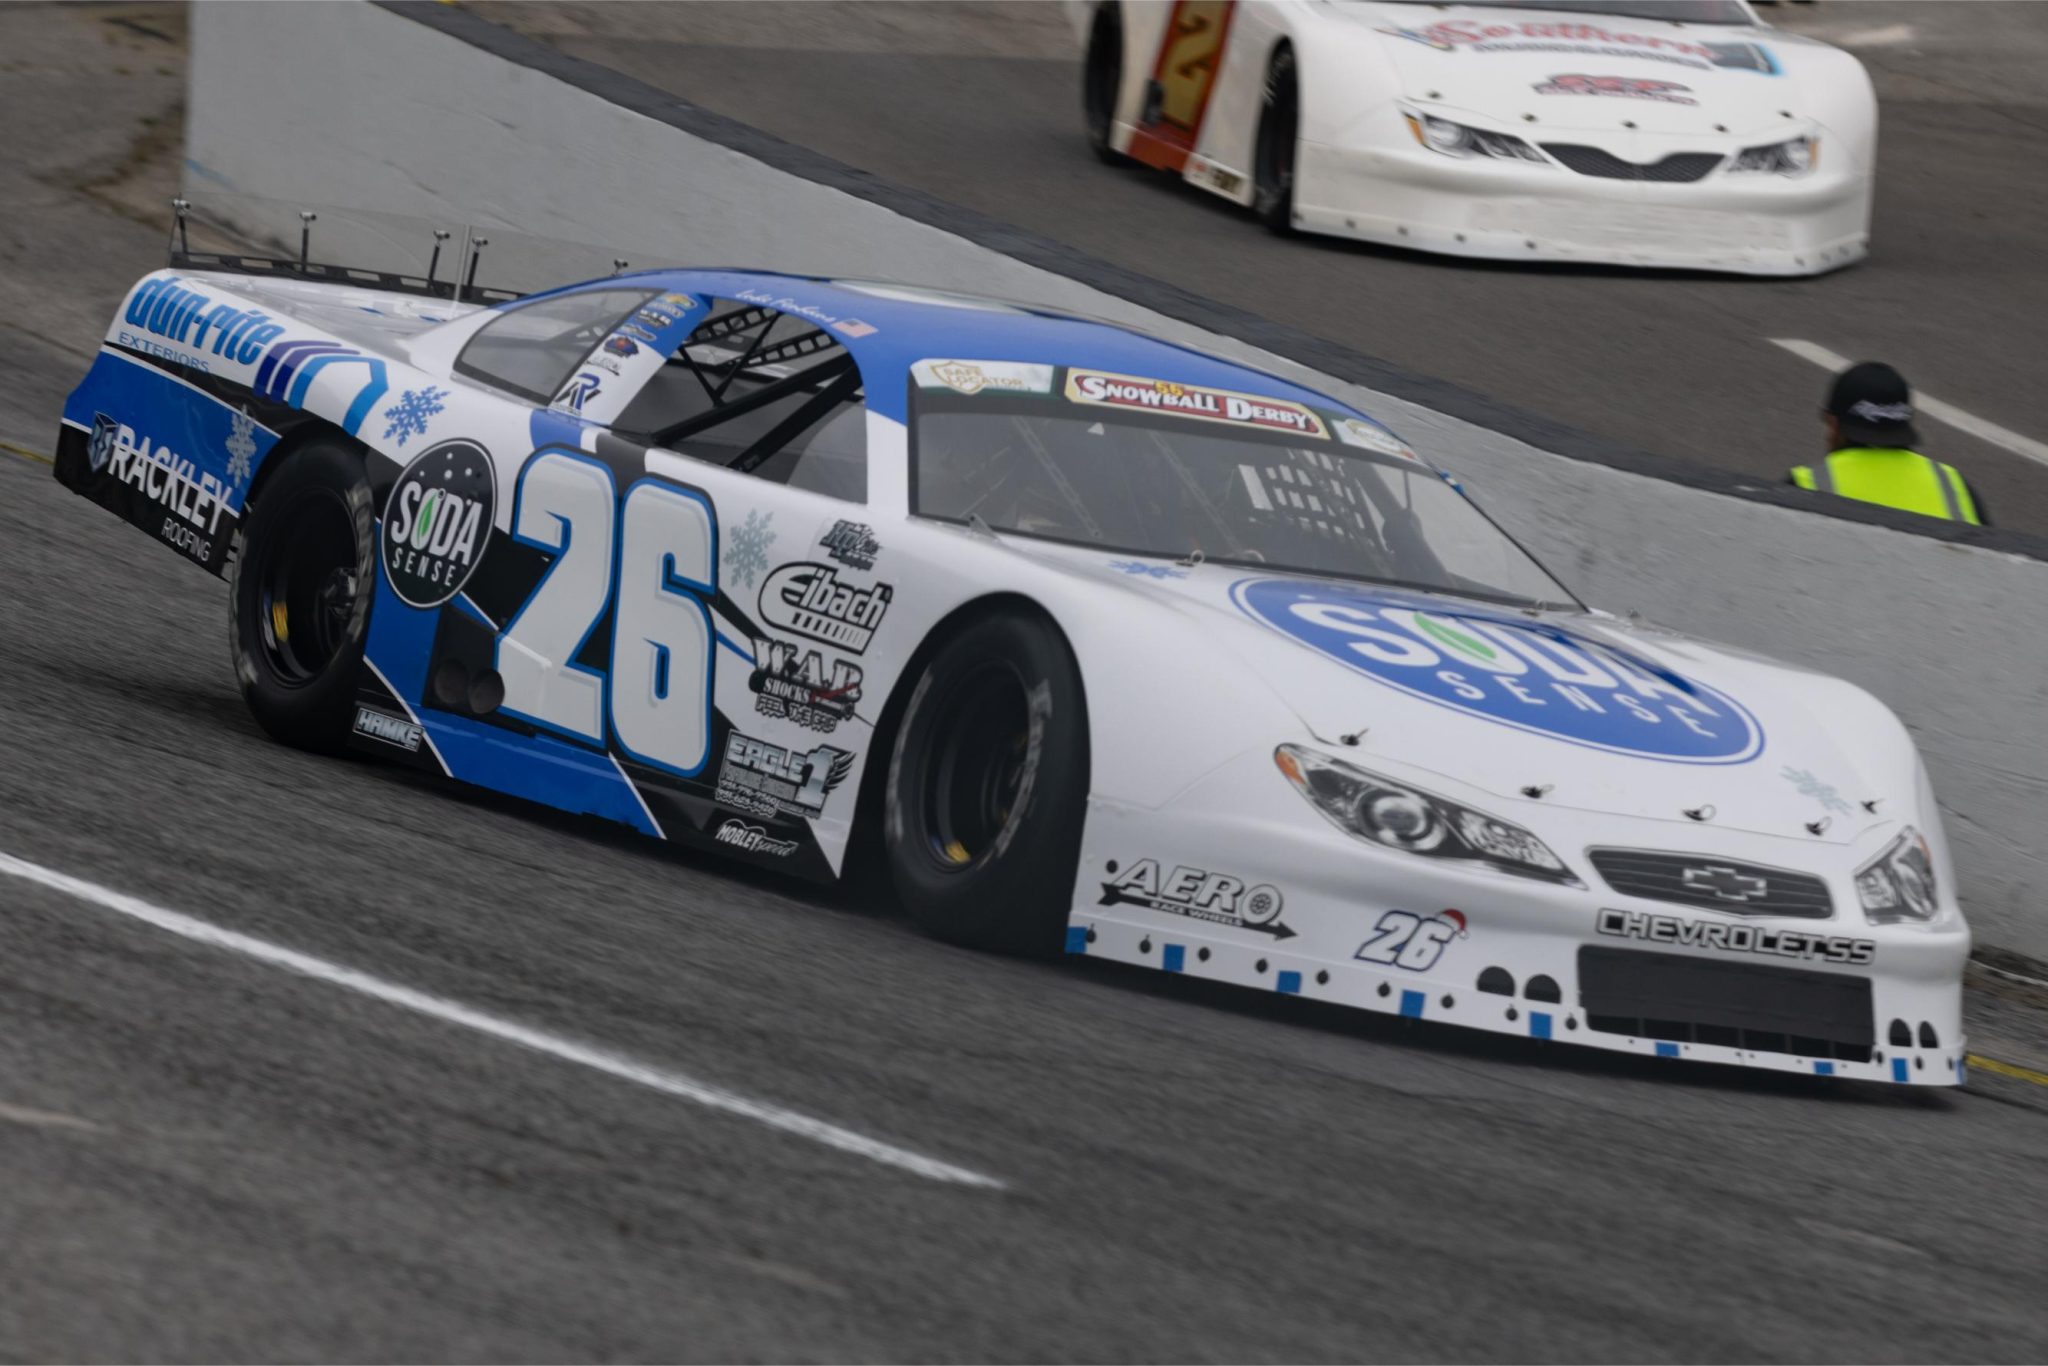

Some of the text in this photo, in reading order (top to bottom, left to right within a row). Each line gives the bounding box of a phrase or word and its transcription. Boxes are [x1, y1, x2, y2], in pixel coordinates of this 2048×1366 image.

[119, 332, 210, 374] EXTERIORS
[1081, 375, 1308, 430] SNOWBALL DERBY
[108, 422, 234, 536] RACKLEY
[161, 516, 212, 562] ROOFING
[391, 481, 483, 567] SODA
[392, 547, 456, 587] SENSE
[494, 447, 718, 778] 26
[758, 561, 892, 635] Eibach
[763, 678, 811, 704] SHOCKS
[1435, 670, 1717, 738] SENSE
[358, 710, 422, 747] HAMKE
[726, 733, 807, 783] EAGLE
[715, 824, 762, 850] MOBLEY
[1109, 857, 1283, 924] AERO
[1150, 901, 1243, 927] RACE WHEELS
[1354, 909, 1456, 972] 26
